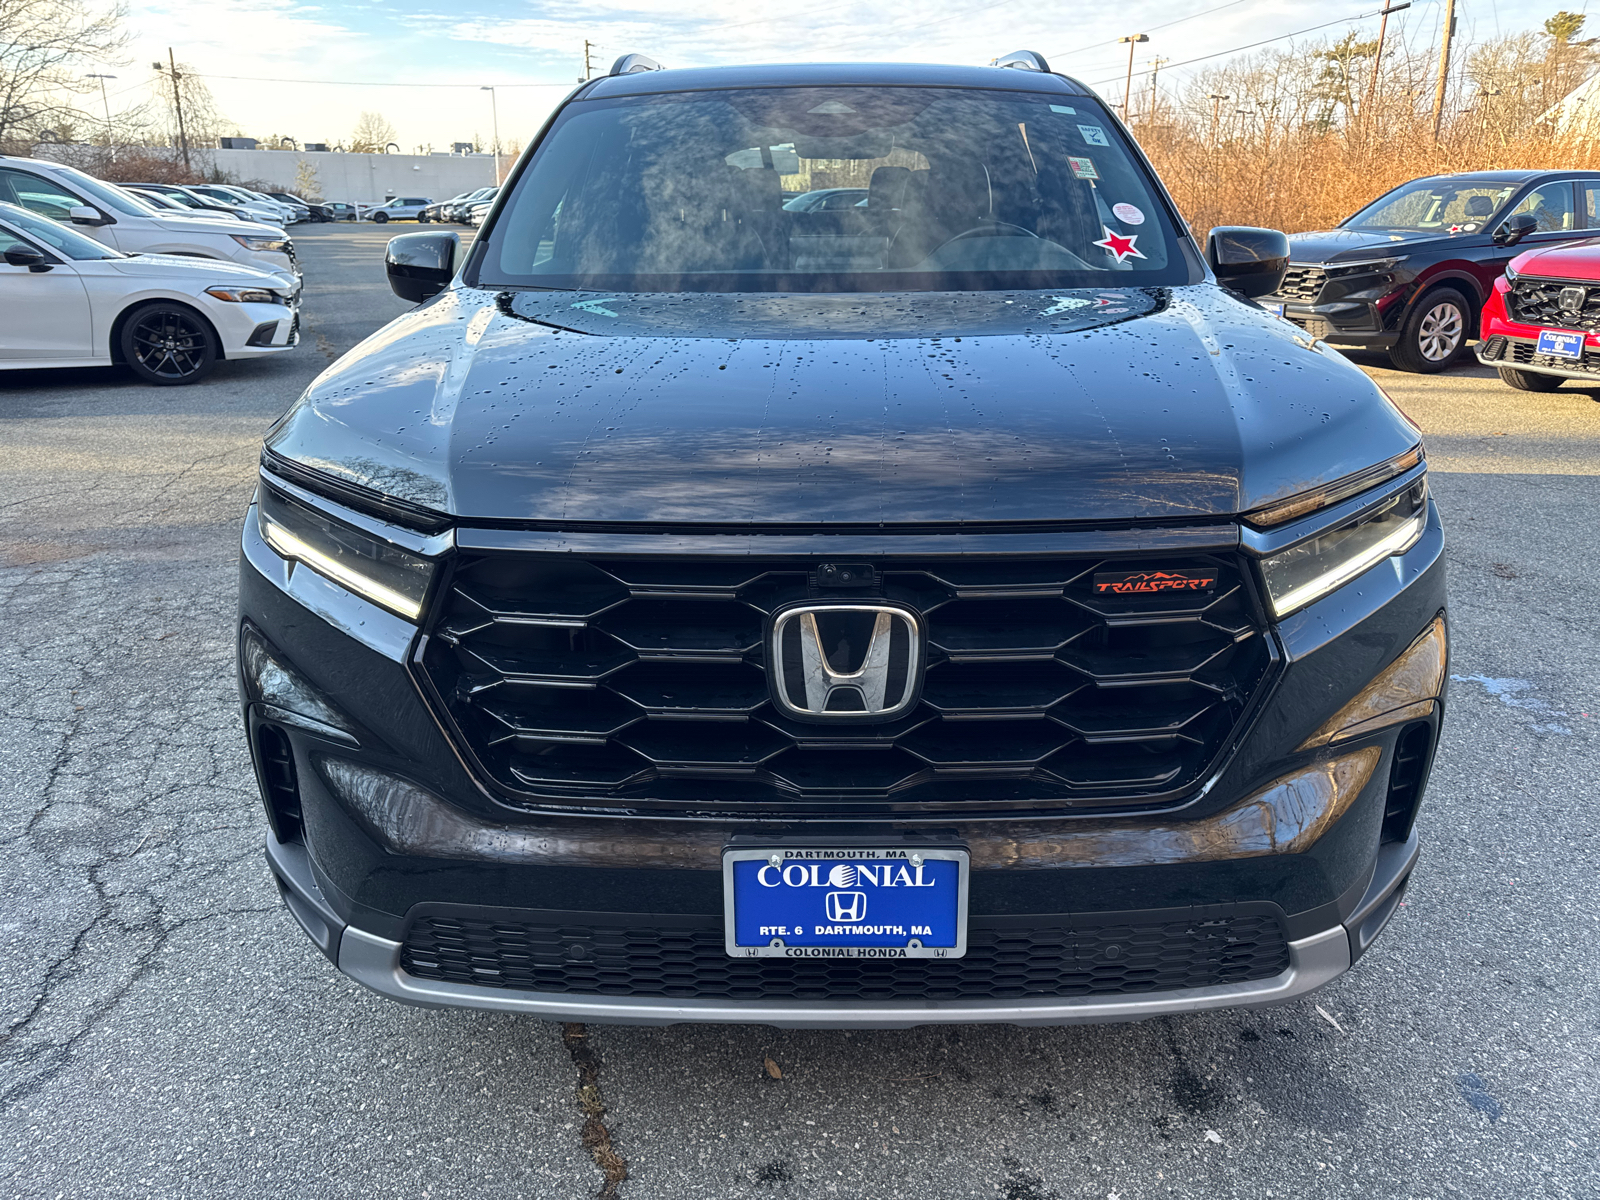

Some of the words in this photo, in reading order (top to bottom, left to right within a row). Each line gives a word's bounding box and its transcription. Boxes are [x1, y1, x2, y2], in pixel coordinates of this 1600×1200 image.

[1543, 333, 1578, 344] COLONIAL
[1096, 578, 1214, 593] TRAILSPORT
[784, 850, 880, 859] DARTMOUTH,
[885, 850, 907, 858] MA
[757, 864, 936, 888] COLONIAL
[759, 926, 791, 936] RTE.
[794, 926, 803, 935] 6
[814, 925, 907, 937] DARTMOUTH,
[910, 925, 933, 936] MA
[785, 948, 854, 957] COLONIAL
[857, 948, 907, 958] HONDA
